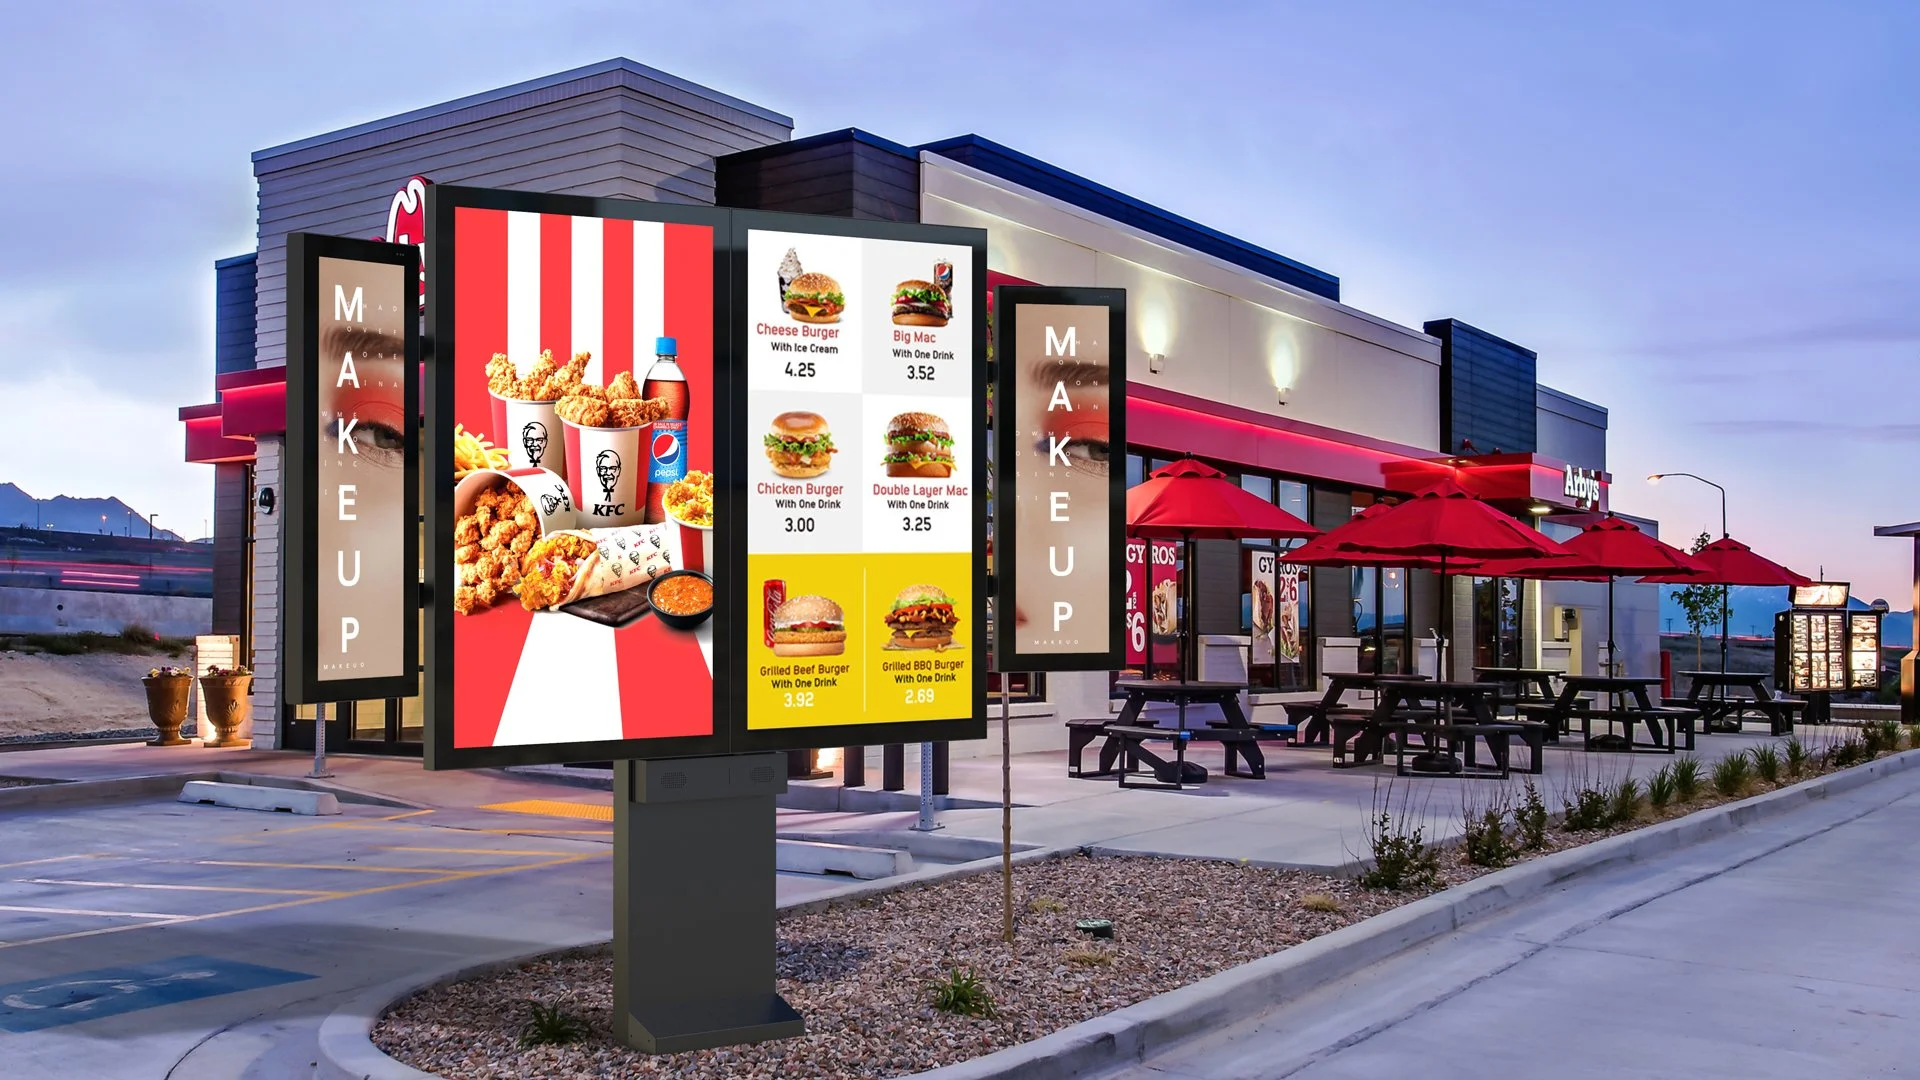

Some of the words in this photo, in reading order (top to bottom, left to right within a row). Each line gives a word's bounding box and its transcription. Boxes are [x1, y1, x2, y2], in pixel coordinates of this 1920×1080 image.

[757, 323, 798, 337] Cheese
[802, 325, 839, 340] Burger
[894, 330, 910, 344] Big
[914, 332, 936, 343] Mac
[771, 342, 792, 351] With
[794, 343, 807, 352] Ice
[810, 344, 838, 354] Cream
[893, 349, 912, 358] With
[915, 349, 930, 359] One
[933, 350, 954, 360] Drink
[785, 362, 816, 377] 4.25
[907, 365, 935, 380] 3.52
[655, 469, 678, 478] pepsi
[758, 483, 802, 494] Chicken
[806, 483, 843, 497] Burger
[873, 484, 910, 495] Double
[914, 485, 943, 498] Layer
[947, 485, 967, 496] Mac
[1565, 464, 1599, 508] Arby's
[554, 484, 570, 512] KFC
[775, 499, 796, 508] With
[799, 499, 816, 508] One
[818, 499, 841, 508] Drink
[887, 500, 907, 509] With
[910, 500, 925, 509] One
[928, 500, 949, 509] Drink
[592, 503, 625, 516] KFC
[785, 517, 814, 532] 3.00
[903, 517, 931, 531] 3.25
[634, 539, 645, 548] KFC
[647, 552, 657, 561] KFC
[630, 566, 641, 575] KFC
[760, 666, 790, 676] Grilled
[794, 665, 815, 675] Beef
[819, 664, 849, 675] Burger
[883, 661, 911, 671] Grilled
[914, 660, 932, 670] BBQ
[935, 660, 964, 671] Burger
[771, 680, 792, 688] With
[795, 679, 812, 688] One
[815, 678, 837, 687] Drink
[895, 675, 914, 683] With
[917, 674, 932, 682] One
[935, 673, 956, 682] Drink
[784, 692, 814, 707] 3.92
[905, 688, 934, 704] 2.69
